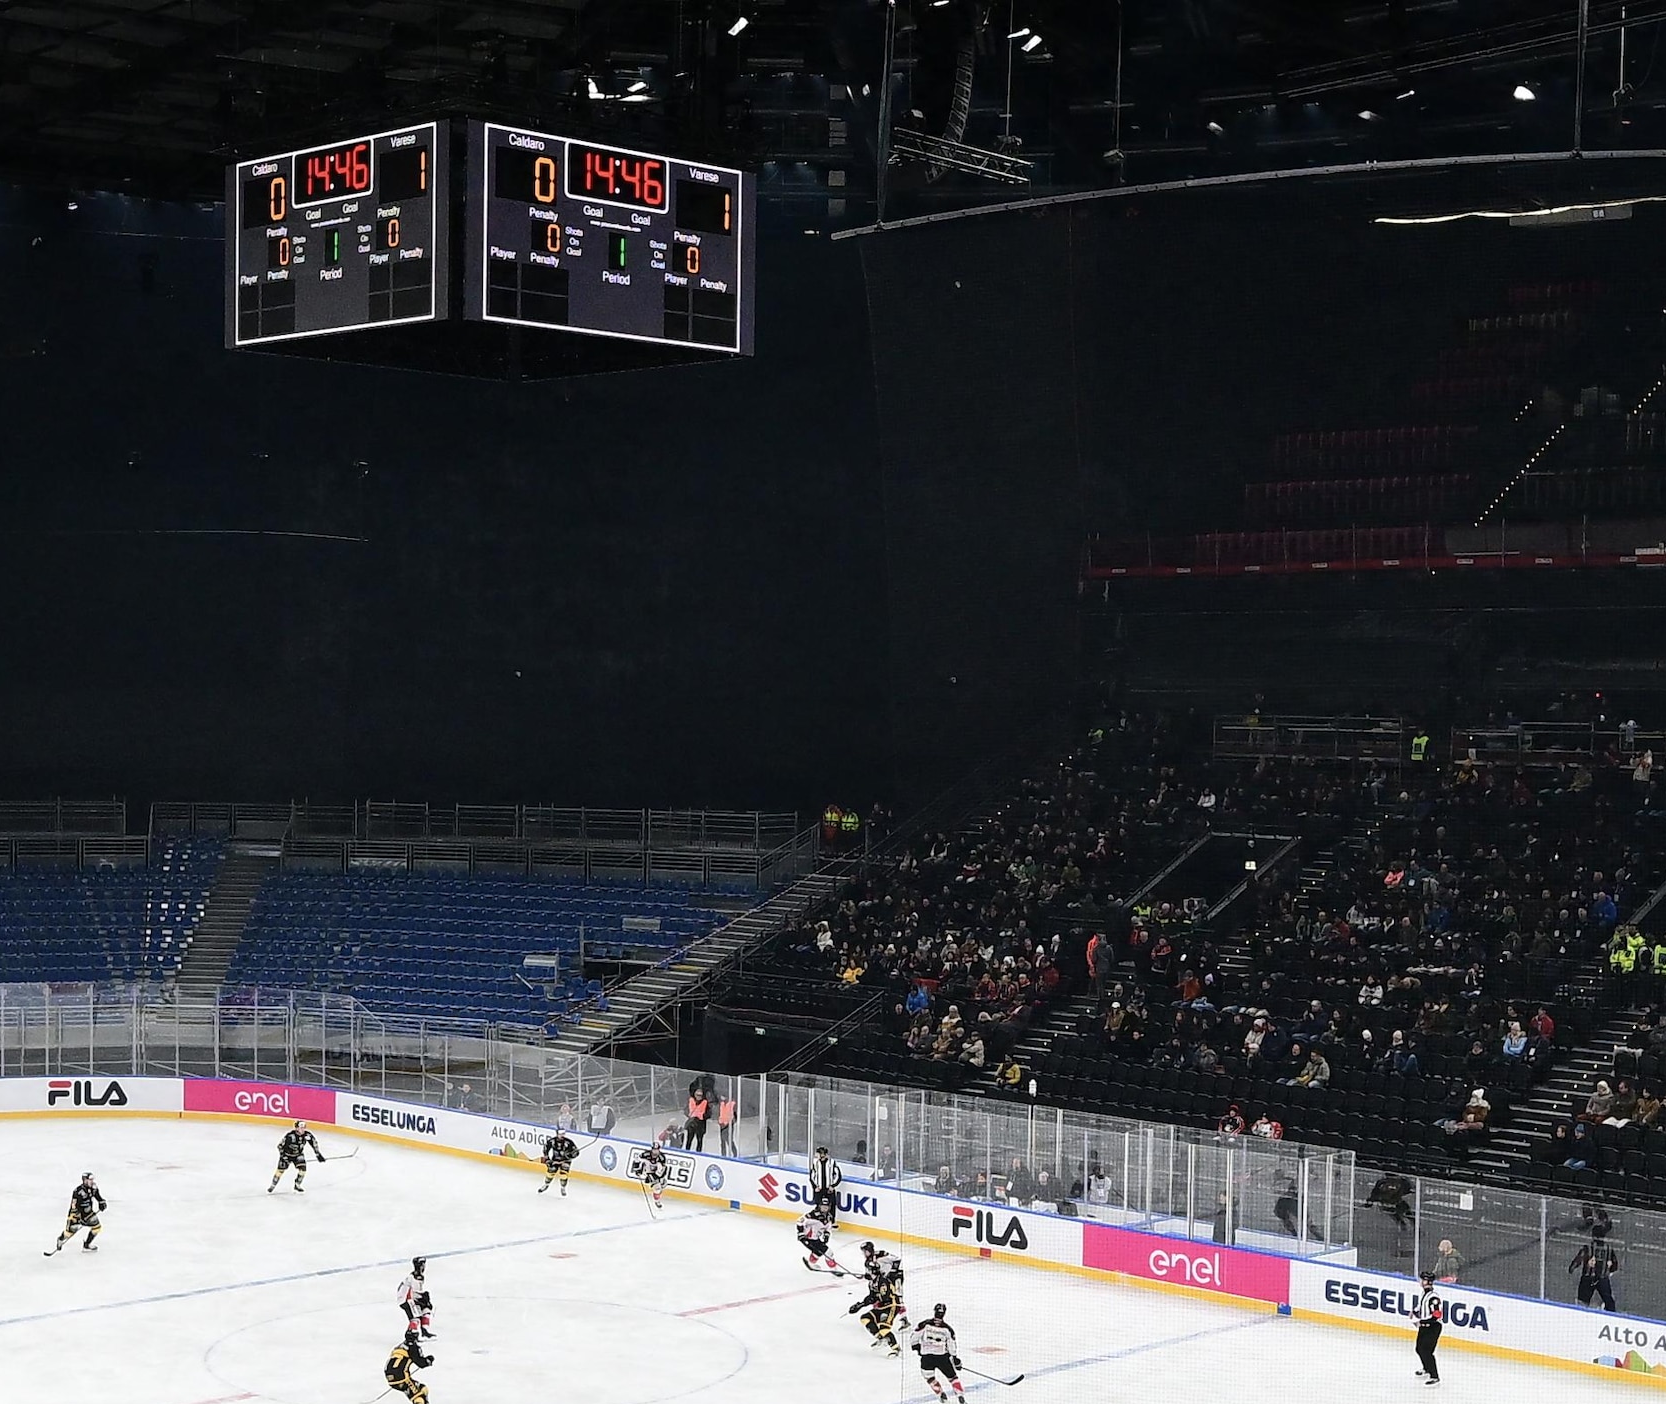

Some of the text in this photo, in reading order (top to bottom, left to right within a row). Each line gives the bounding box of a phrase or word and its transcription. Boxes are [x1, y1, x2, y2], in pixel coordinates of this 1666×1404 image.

[390, 134, 416, 148] Varese
[508, 133, 545, 151] Caldaro
[307, 144, 368, 195] 14:46
[420, 151, 426, 190] 1
[535, 156, 555, 203] 0
[586, 152, 662, 205] 14:46
[689, 167, 720, 183] Varese
[270, 177, 285, 220] 0
[342, 201, 359, 214] Goal
[305, 208, 322, 220] Goal
[529, 207, 558, 222] Penalty
[583, 205, 604, 218] Goal
[631, 213, 651, 226] Goal
[724, 193, 730, 230] 1
[388, 219, 400, 247] 0
[547, 223, 561, 252] 0
[674, 230, 701, 246] Penalty
[279, 238, 289, 266] 0
[334, 232, 339, 260] 1
[490, 246, 516, 260] Player
[620, 238, 625, 267] 1
[530, 252, 559, 268] Penalty
[687, 246, 699, 273] 0
[320, 267, 343, 281] Period
[602, 270, 631, 286] Period
[664, 272, 688, 286] Player
[700, 278, 728, 293] Penalty
[48, 1080, 128, 1106] FILA
[234, 1089, 291, 1114] enel
[352, 1103, 437, 1136] ESSELUNGA
[785, 1182, 878, 1217] SUUKI
[952, 1206, 1029, 1250] FILA
[1148, 1250, 1222, 1287] enel
[1598, 1324, 1648, 1347] ALTO
